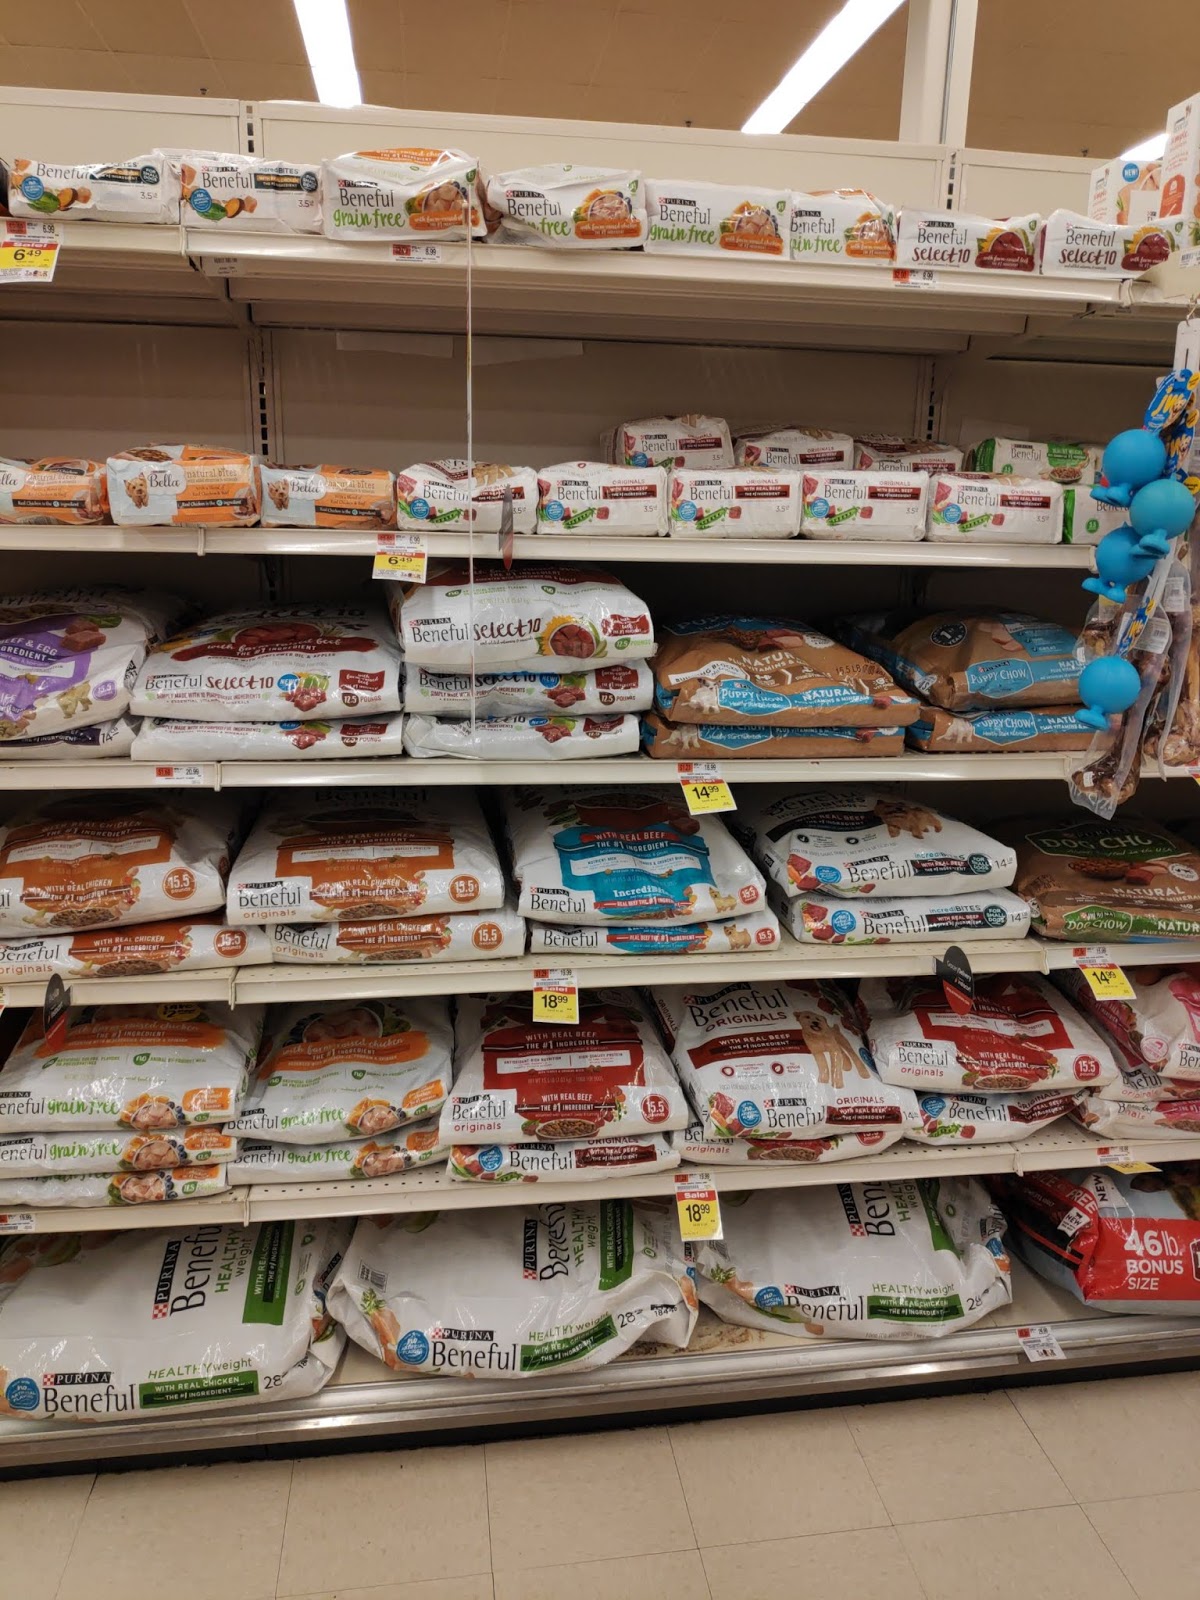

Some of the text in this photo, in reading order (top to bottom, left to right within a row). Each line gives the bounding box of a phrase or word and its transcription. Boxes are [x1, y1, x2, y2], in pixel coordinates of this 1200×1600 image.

[202, 172, 253, 189] Beneful
[1124, 169, 1139, 177] NEW!
[339, 189, 394, 207] Beneful
[665, 198, 696, 207] PURINA
[508, 199, 561, 216] Beneful
[660, 205, 711, 225] Beneful
[333, 209, 372, 228] grain
[372, 209, 405, 228] free
[790, 217, 835, 234] Beneful
[918, 229, 967, 244] Beneful
[1066, 229, 1116, 247] Beneful
[641, 439, 678, 452] Beneful
[1011, 449, 1041, 460] Beneful
[187, 468, 237, 478] natural bites
[149, 474, 180, 488] Bella
[557, 486, 601, 500] Beneful
[690, 486, 733, 499] Beneful
[824, 484, 867, 499] Beneful
[956, 492, 999, 506] Beneful
[417, 618, 451, 626] PURINA
[412, 624, 469, 643] Beneful
[37, 644, 58, 656] EGG
[420, 673, 471, 690] Beneful
[1001, 669, 1027, 680] CHOW
[145, 675, 202, 690] Beneful
[595, 832, 667, 841] WITH REAL BEEF
[849, 860, 912, 883] Beneful
[66, 882, 85, 891] REAL
[85, 879, 113, 889] CHICKEN
[1113, 887, 1185, 896] NATURAL
[239, 888, 301, 907] Beneful
[531, 894, 586, 913] Beneful
[243, 908, 296, 919] originals
[867, 910, 904, 919] PURINA
[929, 905, 981, 913] incrediBITES
[863, 915, 927, 935] Beneful
[1011, 913, 1021, 922] 14
[94, 939, 114, 947] WITH
[134, 935, 165, 943] CHICKEN
[274, 926, 331, 950] Beneful
[544, 930, 598, 947] Beneful
[758, 931, 772, 939] 15.5
[275, 945, 324, 959] originals
[689, 988, 789, 1028] Beneful
[706, 1011, 788, 1033] ORIGINALS
[526, 1033, 549, 1041] WITH
[556, 1039, 600, 1047] INGREDIENT
[718, 1033, 790, 1046] WITH REAL BEEF
[899, 1047, 948, 1066] Beneful
[901, 1067, 944, 1077] originals
[1078, 1060, 1096, 1073] 15.5
[542, 1093, 593, 1102] WITH REAL BEEF
[836, 1096, 884, 1105] ORIGINALS
[452, 1102, 506, 1121] Beneful
[767, 1105, 825, 1129] Beneful
[949, 1105, 1006, 1122] Beneful
[454, 1121, 502, 1134] originals
[50, 1143, 90, 1159] grain
[287, 1149, 352, 1164] grain free
[509, 1151, 573, 1171] Beneful
[1094, 1174, 1109, 1202] NEW
[1067, 1188, 1098, 1214] FREE
[1066, 1212, 1083, 1226] NEW
[1124, 1230, 1162, 1256] 46
[214, 1228, 244, 1294] HEALTHY
[1126, 1260, 1184, 1275] BONUS
[155, 1240, 182, 1302] PURINA
[797, 1286, 840, 1296] PURINA
[872, 1283, 955, 1296] HEALTHY weight
[1128, 1277, 1160, 1290] SIZE
[529, 1312, 609, 1342] HEALTHY weight
[444, 1329, 494, 1341] PURINA
[432, 1341, 517, 1372] Beneful
[56, 1372, 112, 1385] PURINA
[154, 1377, 240, 1393] WITH REAL CHICKEN
[263, 1374, 282, 1390] 28
[43, 1384, 136, 1413] Beneful
[189, 1387, 232, 1398] INGREDIENT
